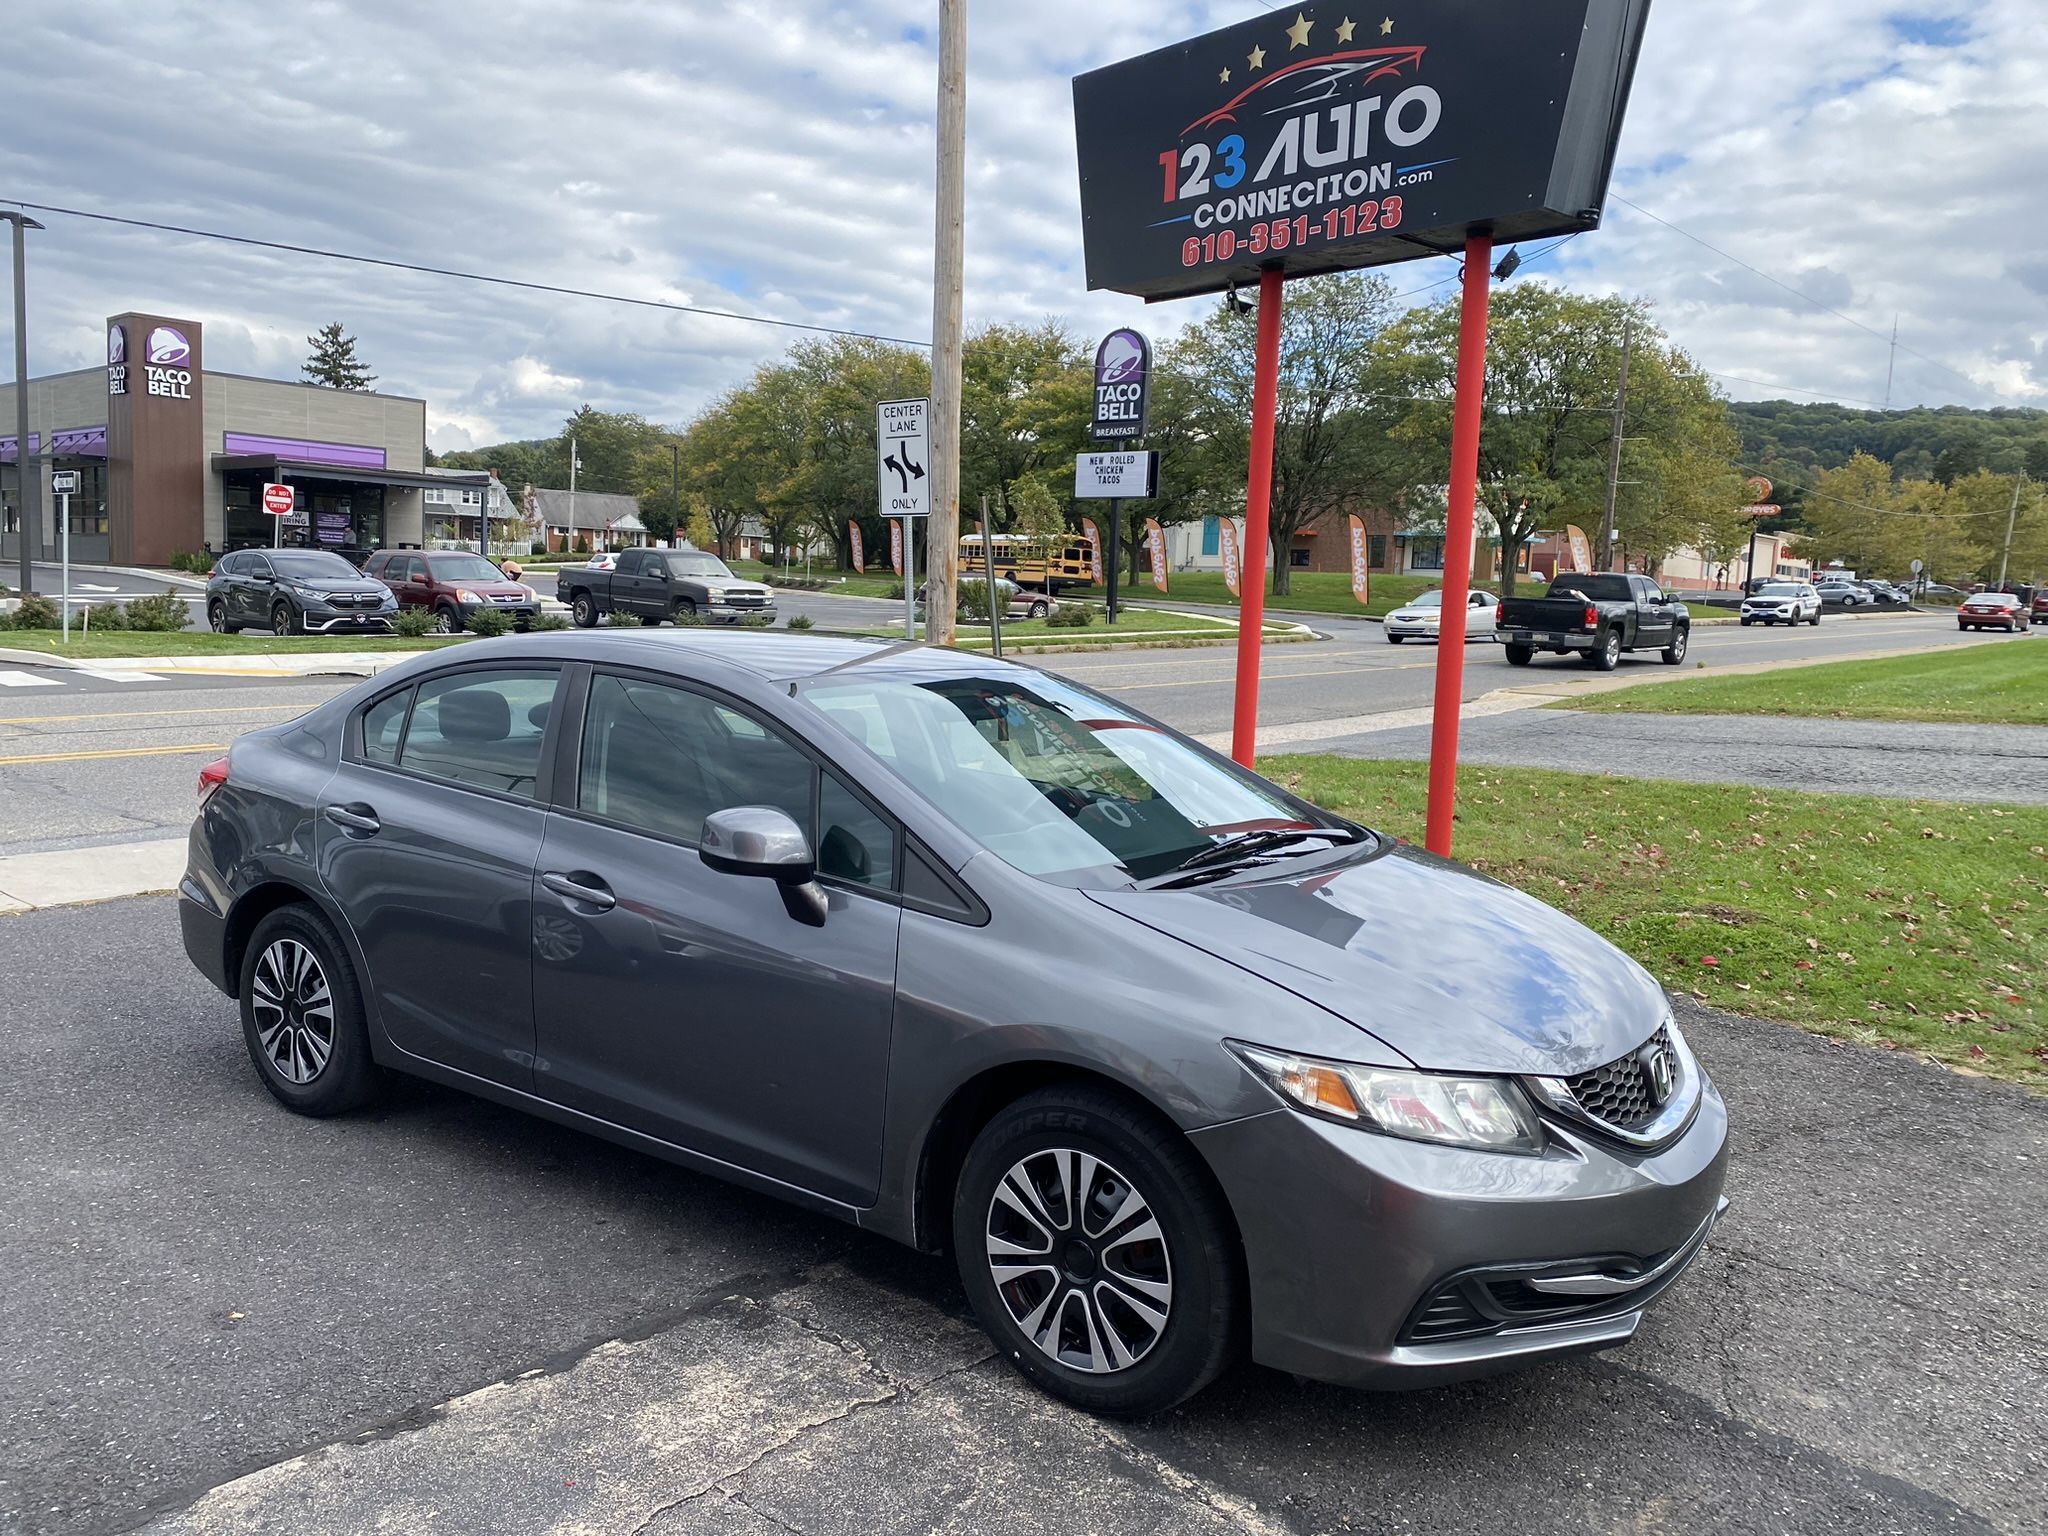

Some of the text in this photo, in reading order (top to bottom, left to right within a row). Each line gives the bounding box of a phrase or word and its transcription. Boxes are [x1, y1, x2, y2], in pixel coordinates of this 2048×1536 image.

[1159, 84, 1442, 204] 123 AUTO
[1182, 195, 1403, 267] 610-351-1123
[108, 366, 125, 380] TACO
[144, 365, 191, 385] TACO
[110, 380, 125, 395] BELL
[148, 380, 191, 399] BELL
[1096, 383, 1141, 403] TACO
[884, 404, 922, 418] CENTER
[1098, 402, 1139, 421] BELL
[890, 420, 916, 432] LANE
[1096, 427, 1135, 437] BREAKFAST
[1090, 455, 1135, 466] NEW ROLLED
[1095, 465, 1124, 475] CHICKEN
[1098, 475, 1120, 484] TACOS
[892, 498, 918, 509] ONLY
